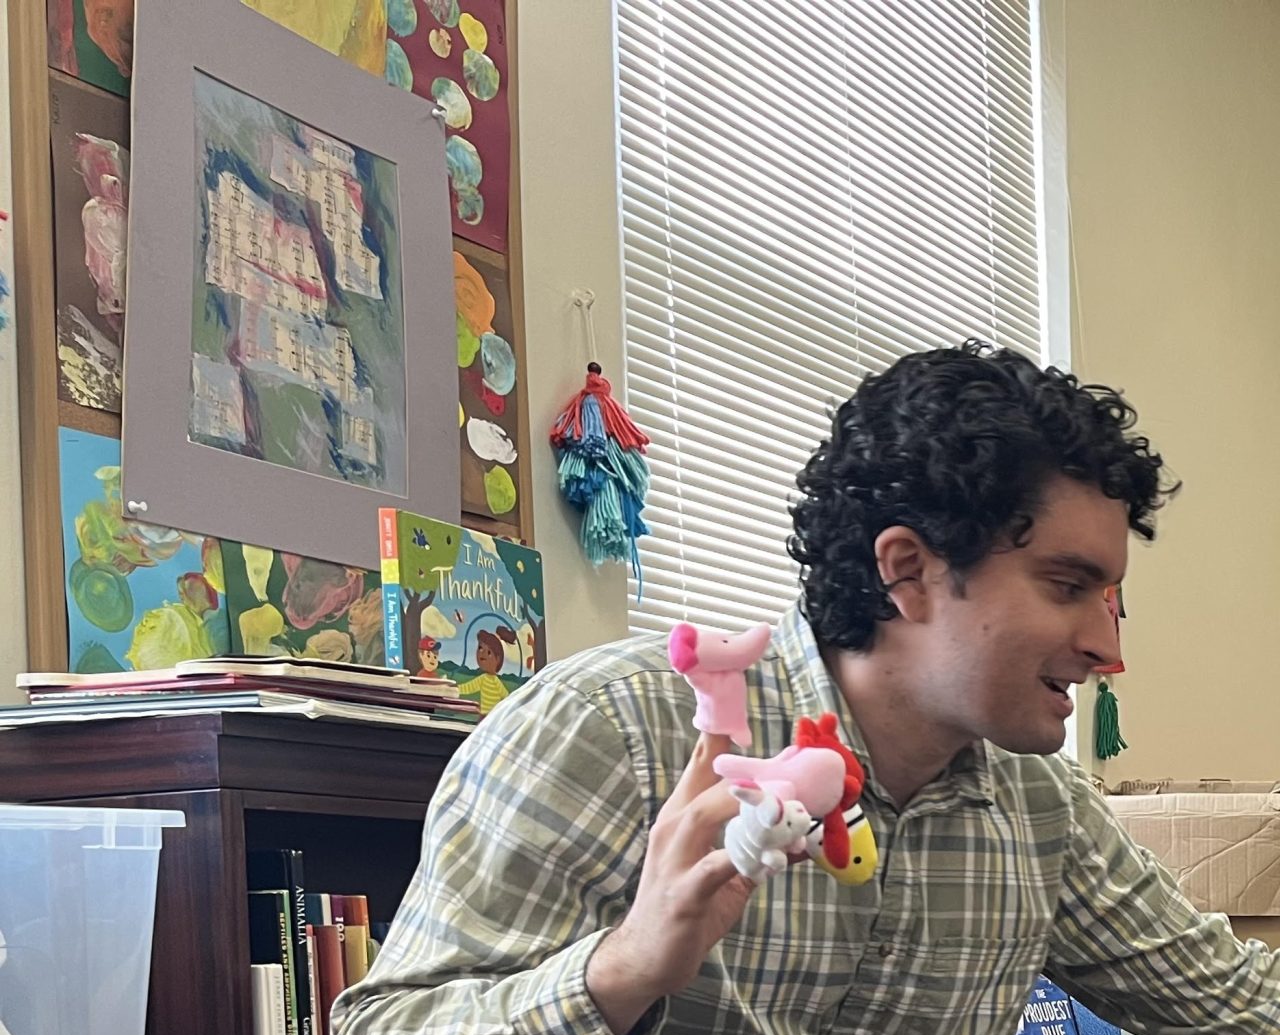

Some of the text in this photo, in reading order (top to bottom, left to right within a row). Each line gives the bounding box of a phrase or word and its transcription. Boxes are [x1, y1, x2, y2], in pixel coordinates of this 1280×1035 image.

[463, 544, 495, 571] I Am
[388, 601, 397, 614] Am
[431, 566, 522, 622] Thankful
[388, 614, 399, 650] Thankful
[295, 885, 307, 946] ANIMALIA
[279, 912, 288, 954] REPTILES
[1035, 989, 1046, 999] THE
[1023, 1000, 1071, 1023] PROUDEST
